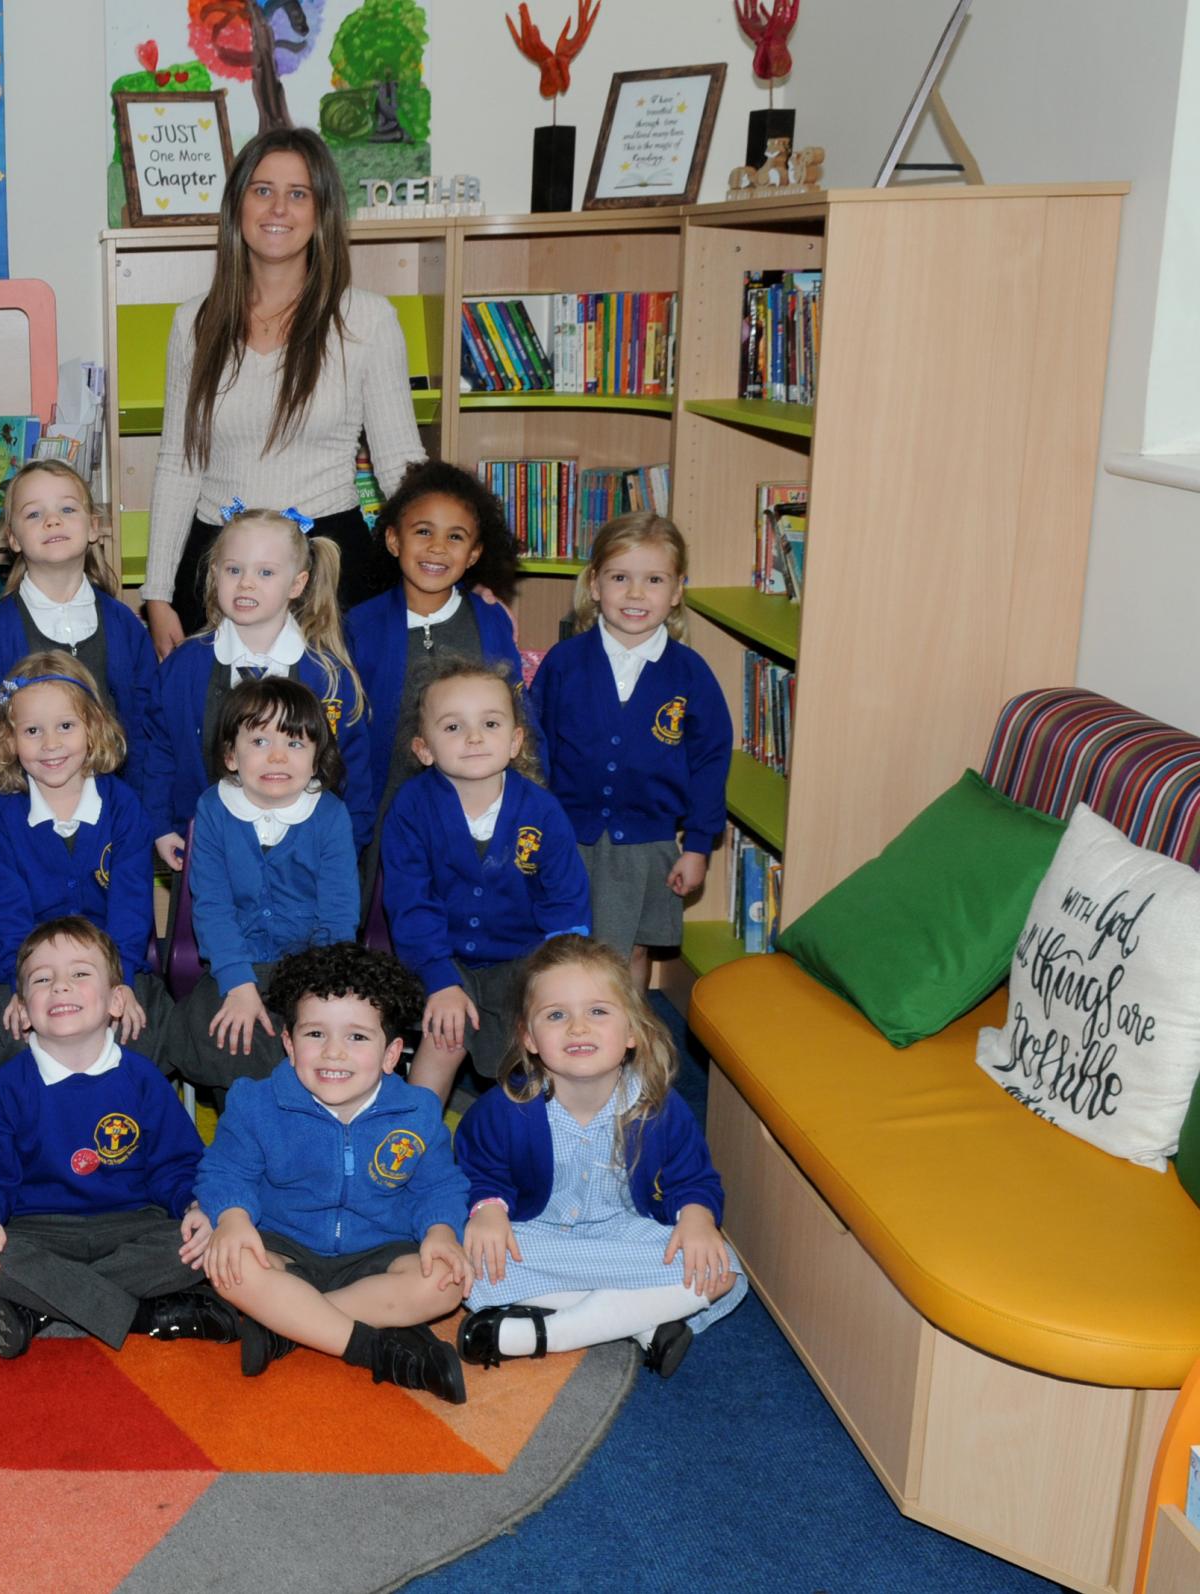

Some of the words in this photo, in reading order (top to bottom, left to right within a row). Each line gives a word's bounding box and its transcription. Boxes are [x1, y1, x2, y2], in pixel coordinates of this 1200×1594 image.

[151, 124, 198, 143] JUST
[150, 150, 175, 161] One
[179, 150, 211, 161] More
[144, 166, 217, 195] Chapter
[359, 175, 481, 207] TOGETHER
[1060, 887, 1100, 925] WITH
[1031, 926, 1126, 1050] things
[1118, 1003, 1157, 1046] are
[993, 1001, 1123, 1121] possible
